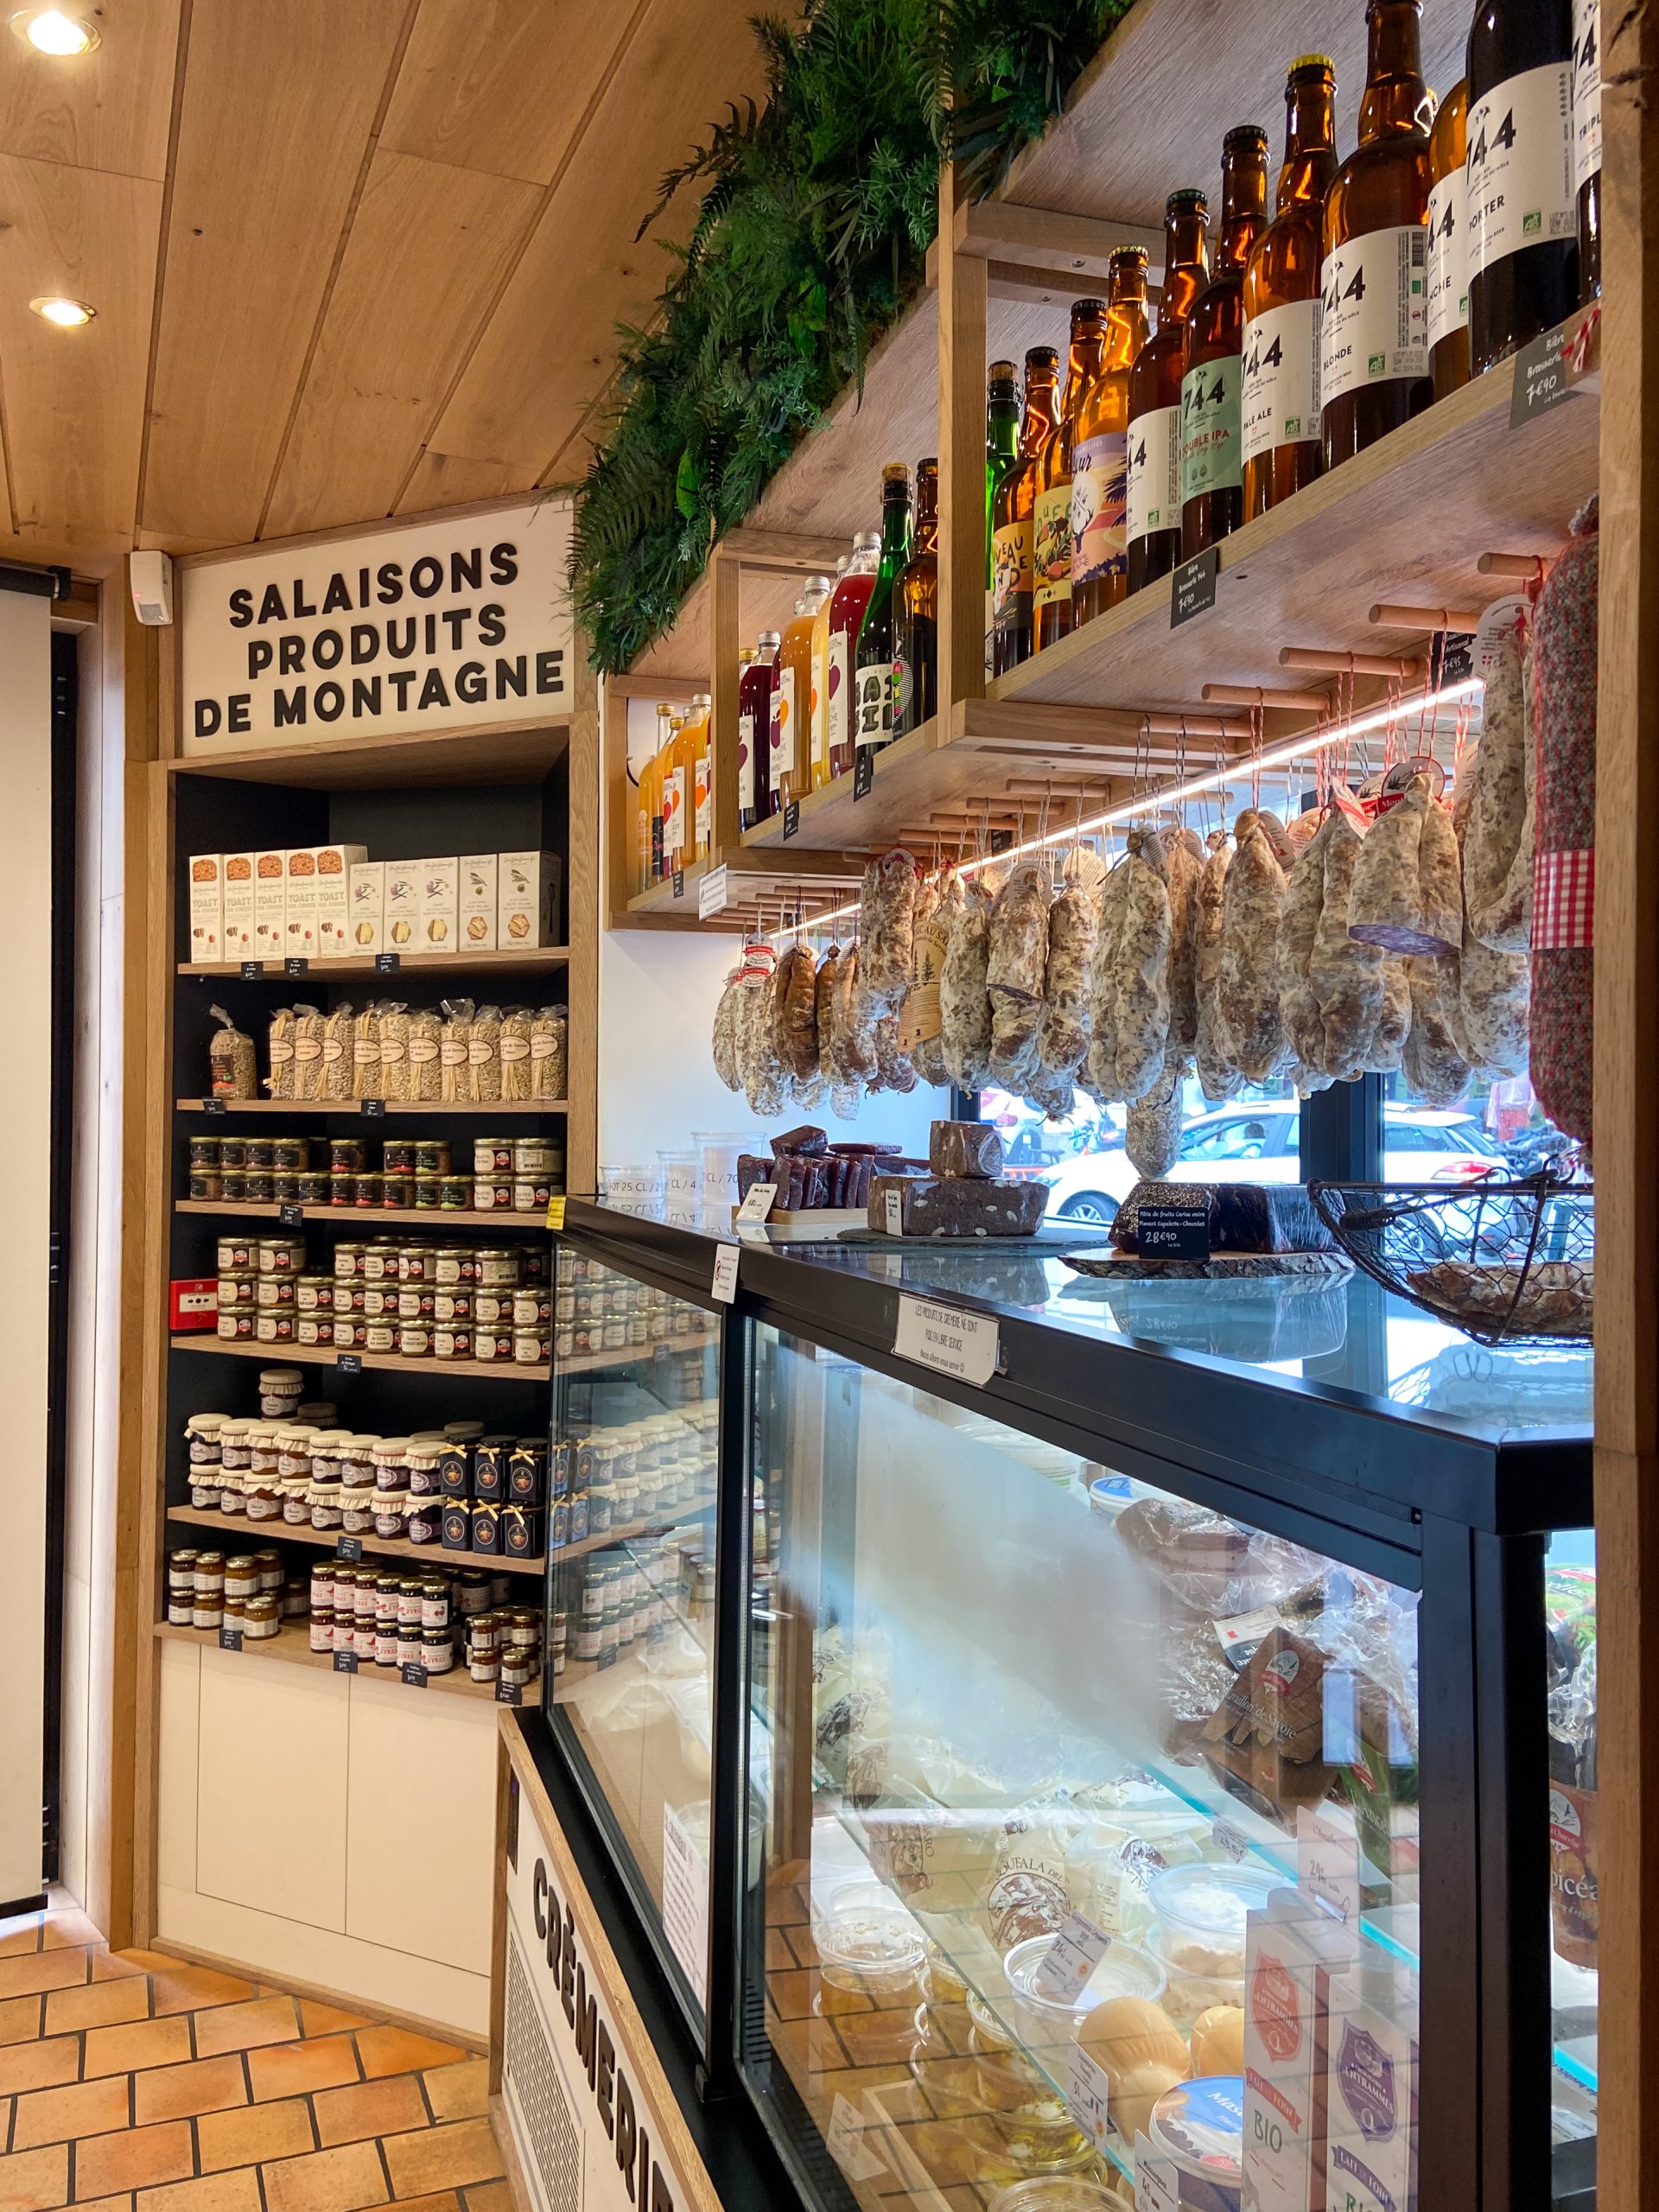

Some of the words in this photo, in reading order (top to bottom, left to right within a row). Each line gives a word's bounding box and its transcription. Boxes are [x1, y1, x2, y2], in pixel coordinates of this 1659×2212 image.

[1324, 346, 1352, 372] BLONDE
[1185, 376, 1225, 421] 744
[1256, 408, 1272, 421] ALE
[1211, 429, 1230, 442] IPA
[229, 543, 518, 628] SALAISONS
[248, 603, 506, 679] PRODUITS
[194, 693, 251, 737] DE
[274, 650, 564, 728] MONTAGNE
[193, 898, 219, 908] TOAST
[226, 897, 252, 907] TOAST
[257, 895, 283, 905] TOAST
[288, 893, 315, 903] TOAST
[318, 892, 345, 901] TOAST
[671, 1180, 681, 1189] CL
[707, 1173, 716, 1183] CL
[622, 1182, 632, 1192] 25
[636, 1182, 647, 1192] CL
[1145, 1231, 1177, 1243] 28€90
[968, 1319, 978, 1334] SONT
[938, 1333, 948, 1347] LIBRE
[949, 1336, 963, 1352] SERVICE
[920, 1349, 929, 1360] Nous
[929, 1352, 940, 1364] allons
[940, 1357, 949, 1367] vous
[1255, 1707, 1267, 1719] de
[1265, 1711, 1296, 1739] Savoie
[1249, 2072, 1265, 2096] LAIT
[1274, 2094, 1294, 2118] FOIN
[1255, 2108, 1283, 2154] BIO
[1339, 2151, 1358, 2173] LAIT
[1368, 2174, 1389, 2204] FOIN
